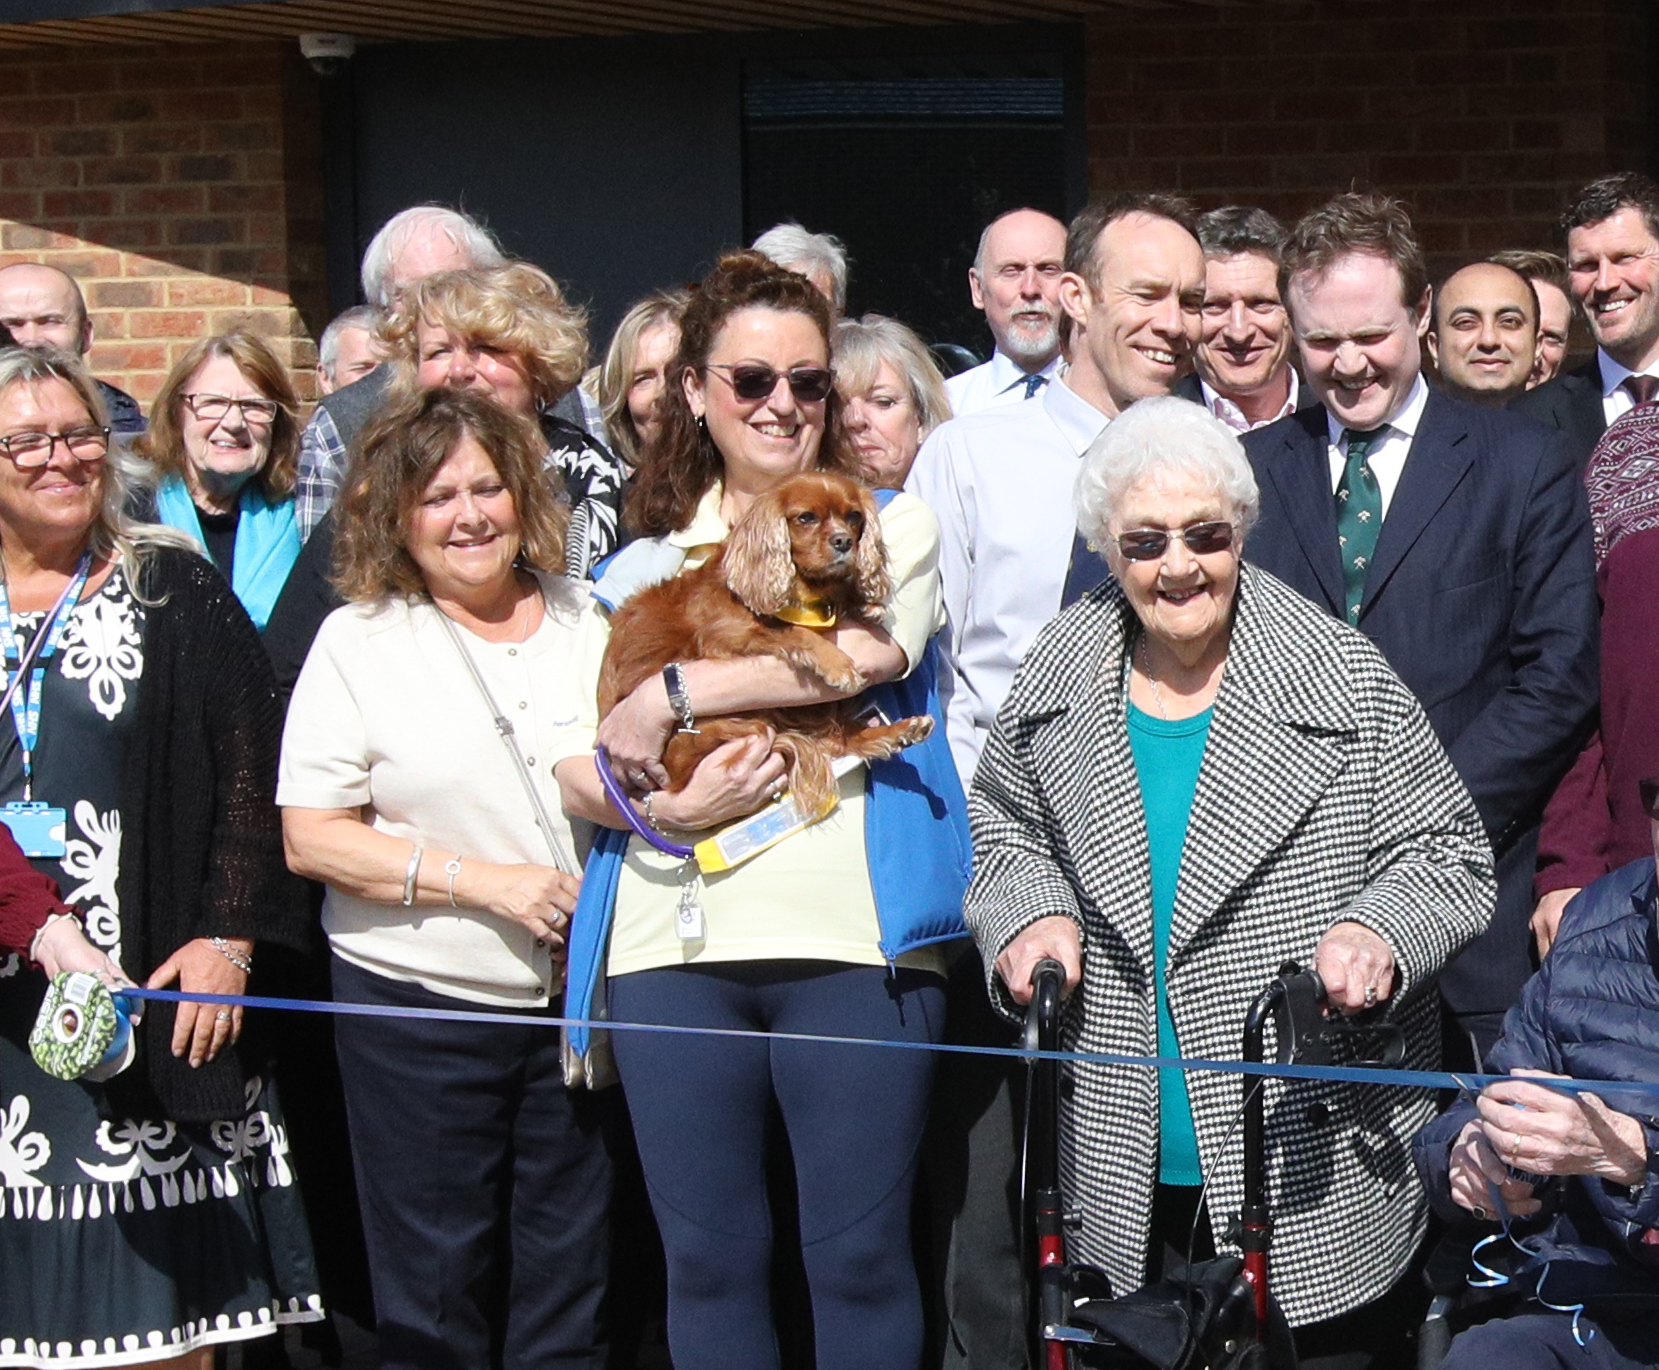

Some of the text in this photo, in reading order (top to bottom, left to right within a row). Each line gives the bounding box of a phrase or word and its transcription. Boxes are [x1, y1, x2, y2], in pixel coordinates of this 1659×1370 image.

[0, 627, 14, 648] NHS
[26, 680, 41, 736] NHS NHS
